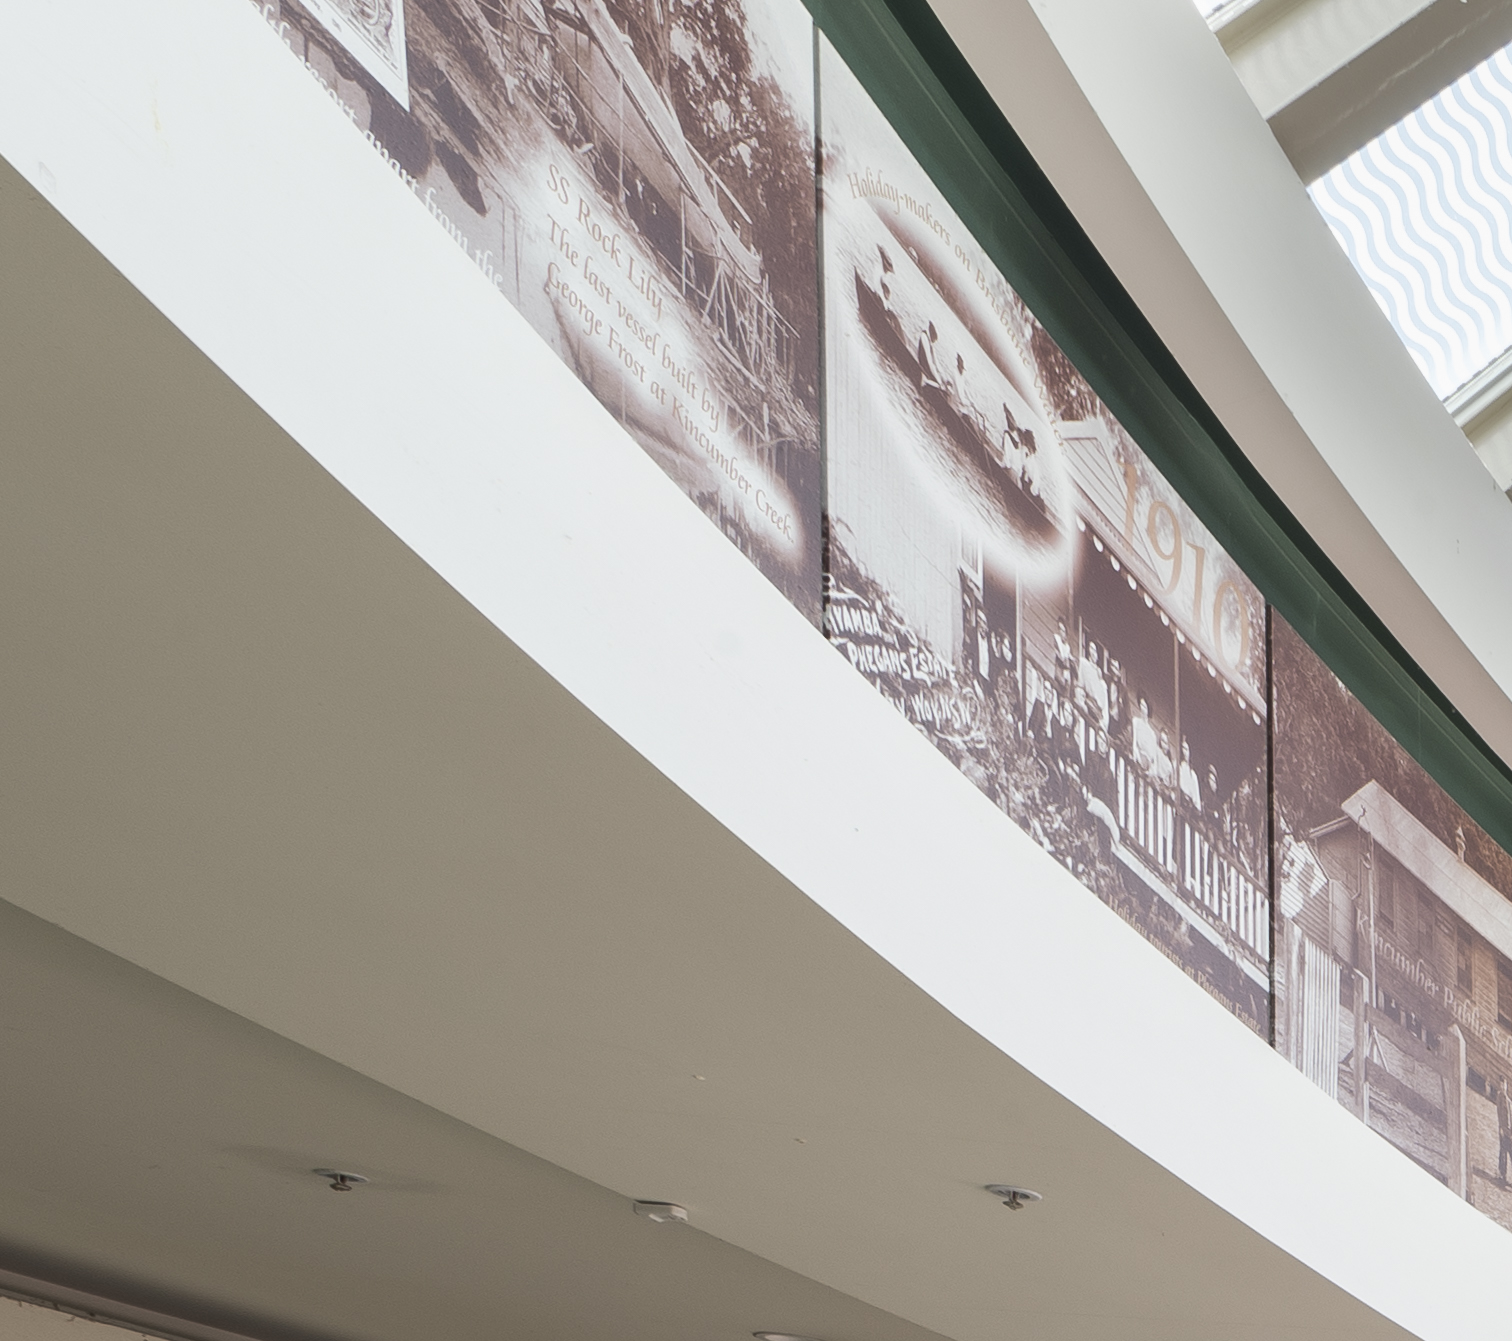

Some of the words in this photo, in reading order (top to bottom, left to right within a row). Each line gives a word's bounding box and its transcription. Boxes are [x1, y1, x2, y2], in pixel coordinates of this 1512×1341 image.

[545, 162, 570, 206] SS
[577, 200, 622, 263] Rock
[625, 257, 664, 322] Lily
[547, 214, 580, 264] The
[583, 259, 614, 300] last
[615, 300, 660, 357] vessel
[661, 345, 700, 398] built
[700, 383, 722, 433] by
[847, 167, 953, 249] Holiday-makers
[955, 243, 972, 273] on
[975, 268, 1032, 368] Brisbane
[547, 262, 603, 339] George
[607, 325, 647, 384] Frost
[650, 378, 668, 407] at
[670, 394, 753, 498] Kincumber
[755, 488, 796, 544] Creek.
[1117, 458, 1250, 674] 1910
